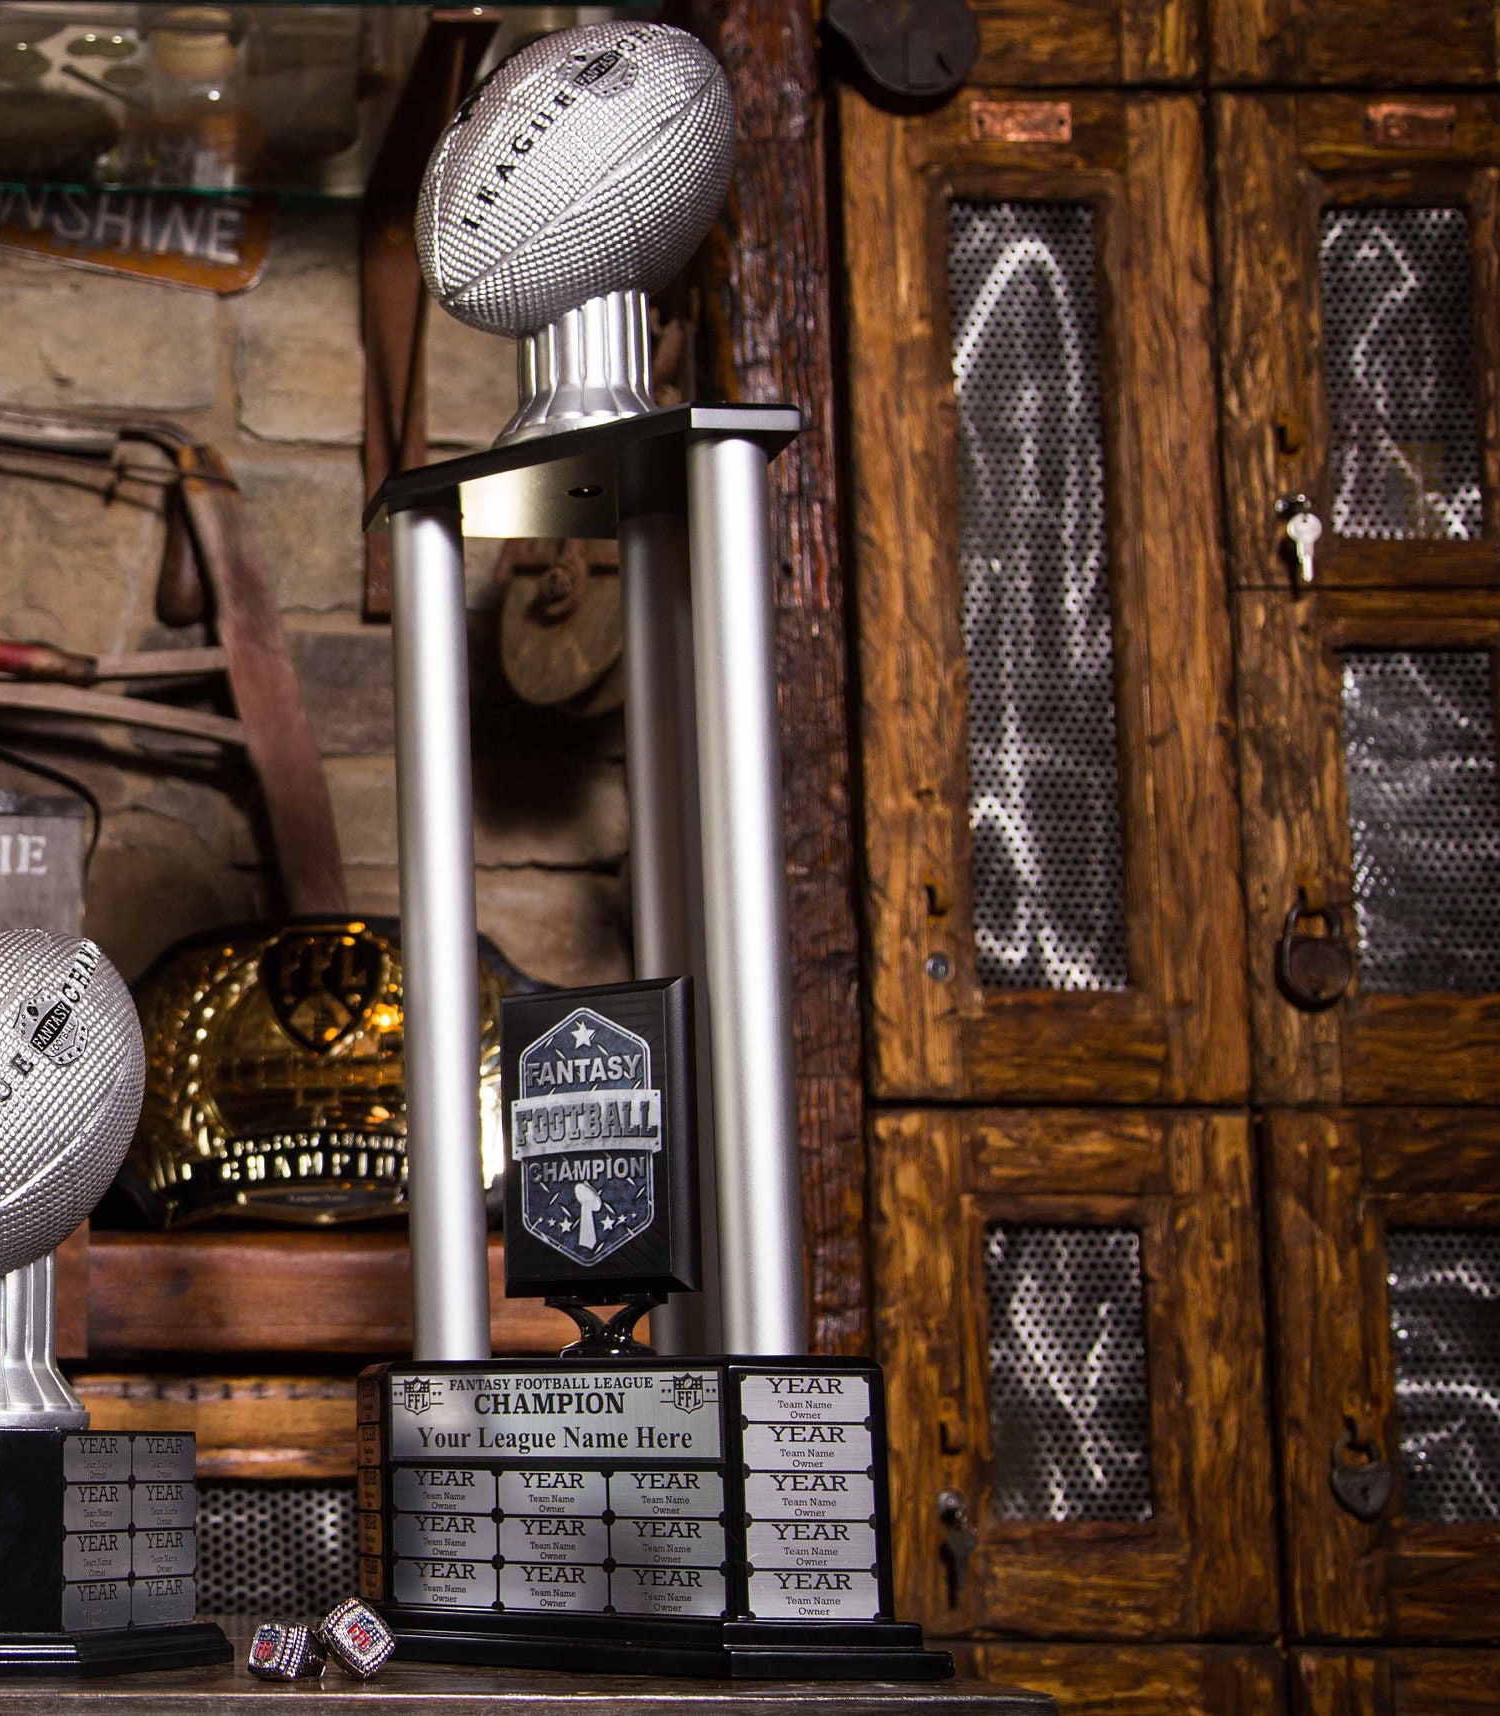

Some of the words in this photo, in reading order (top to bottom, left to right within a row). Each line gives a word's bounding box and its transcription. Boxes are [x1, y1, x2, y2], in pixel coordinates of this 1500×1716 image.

[32, 1004, 71, 1051] FANTASY
[527, 1054, 642, 1087] FANTASY
[515, 1100, 658, 1147] FOOTBALL
[528, 1156, 646, 1183] CHAMPION
[449, 1378, 511, 1390] FANTASY
[515, 1377, 590, 1390] FOOTBALL
[594, 1376, 654, 1389] LEAGUE
[766, 1377, 844, 1394] YEAR
[407, 1392, 429, 1408] FFL
[474, 1391, 625, 1415] CHAMPION
[677, 1390, 700, 1407] FFL
[778, 1400, 803, 1409] Team
[805, 1400, 832, 1409] Name
[790, 1411, 822, 1419] Owner
[417, 1427, 471, 1448] Your
[478, 1427, 556, 1454] League
[562, 1426, 629, 1448] Name
[635, 1426, 693, 1449] Here
[768, 1426, 846, 1443] YEAR
[78, 1437, 118, 1454] YEAR
[146, 1437, 184, 1454] YEAR
[780, 1449, 805, 1457] Team
[807, 1449, 834, 1457] Name
[792, 1460, 824, 1468] Owner
[413, 1470, 475, 1487] YEAR
[519, 1472, 584, 1489] YEAR
[631, 1473, 700, 1489] YEAR
[770, 1475, 848, 1491] YEAR
[77, 1486, 119, 1503] YEAR
[146, 1485, 184, 1501] YEAR
[528, 1494, 550, 1503] Team
[551, 1494, 575, 1503] Name
[641, 1496, 664, 1504] Team
[665, 1496, 690, 1504] Name
[539, 1505, 565, 1513] Owner
[652, 1506, 680, 1514] Owner
[781, 1498, 807, 1506] Team
[809, 1498, 837, 1506] Name
[794, 1508, 826, 1517] Owner
[414, 1516, 476, 1533] YEAR
[520, 1519, 586, 1536] YEAR
[632, 1521, 701, 1538] YEAR
[771, 1524, 850, 1541] YEAR
[77, 1534, 118, 1552] YEAR
[145, 1532, 184, 1549] YEAR
[529, 1542, 551, 1550] Team
[552, 1542, 576, 1551] Name
[540, 1552, 567, 1560] Owner
[783, 1547, 809, 1555] Team
[811, 1547, 838, 1555] Name
[796, 1558, 827, 1566] Owner
[414, 1562, 476, 1580] YEAR
[520, 1566, 586, 1583] YEAR
[633, 1569, 702, 1587] YEAR
[145, 1579, 184, 1597] YEAR
[774, 1572, 852, 1590] YEAR
[77, 1583, 118, 1602] YEAR
[529, 1588, 551, 1597] Team
[552, 1589, 576, 1598] Name
[786, 1596, 812, 1605] Team
[813, 1596, 841, 1605] Name
[540, 1599, 567, 1607] Owner
[798, 1607, 830, 1616] Owner
